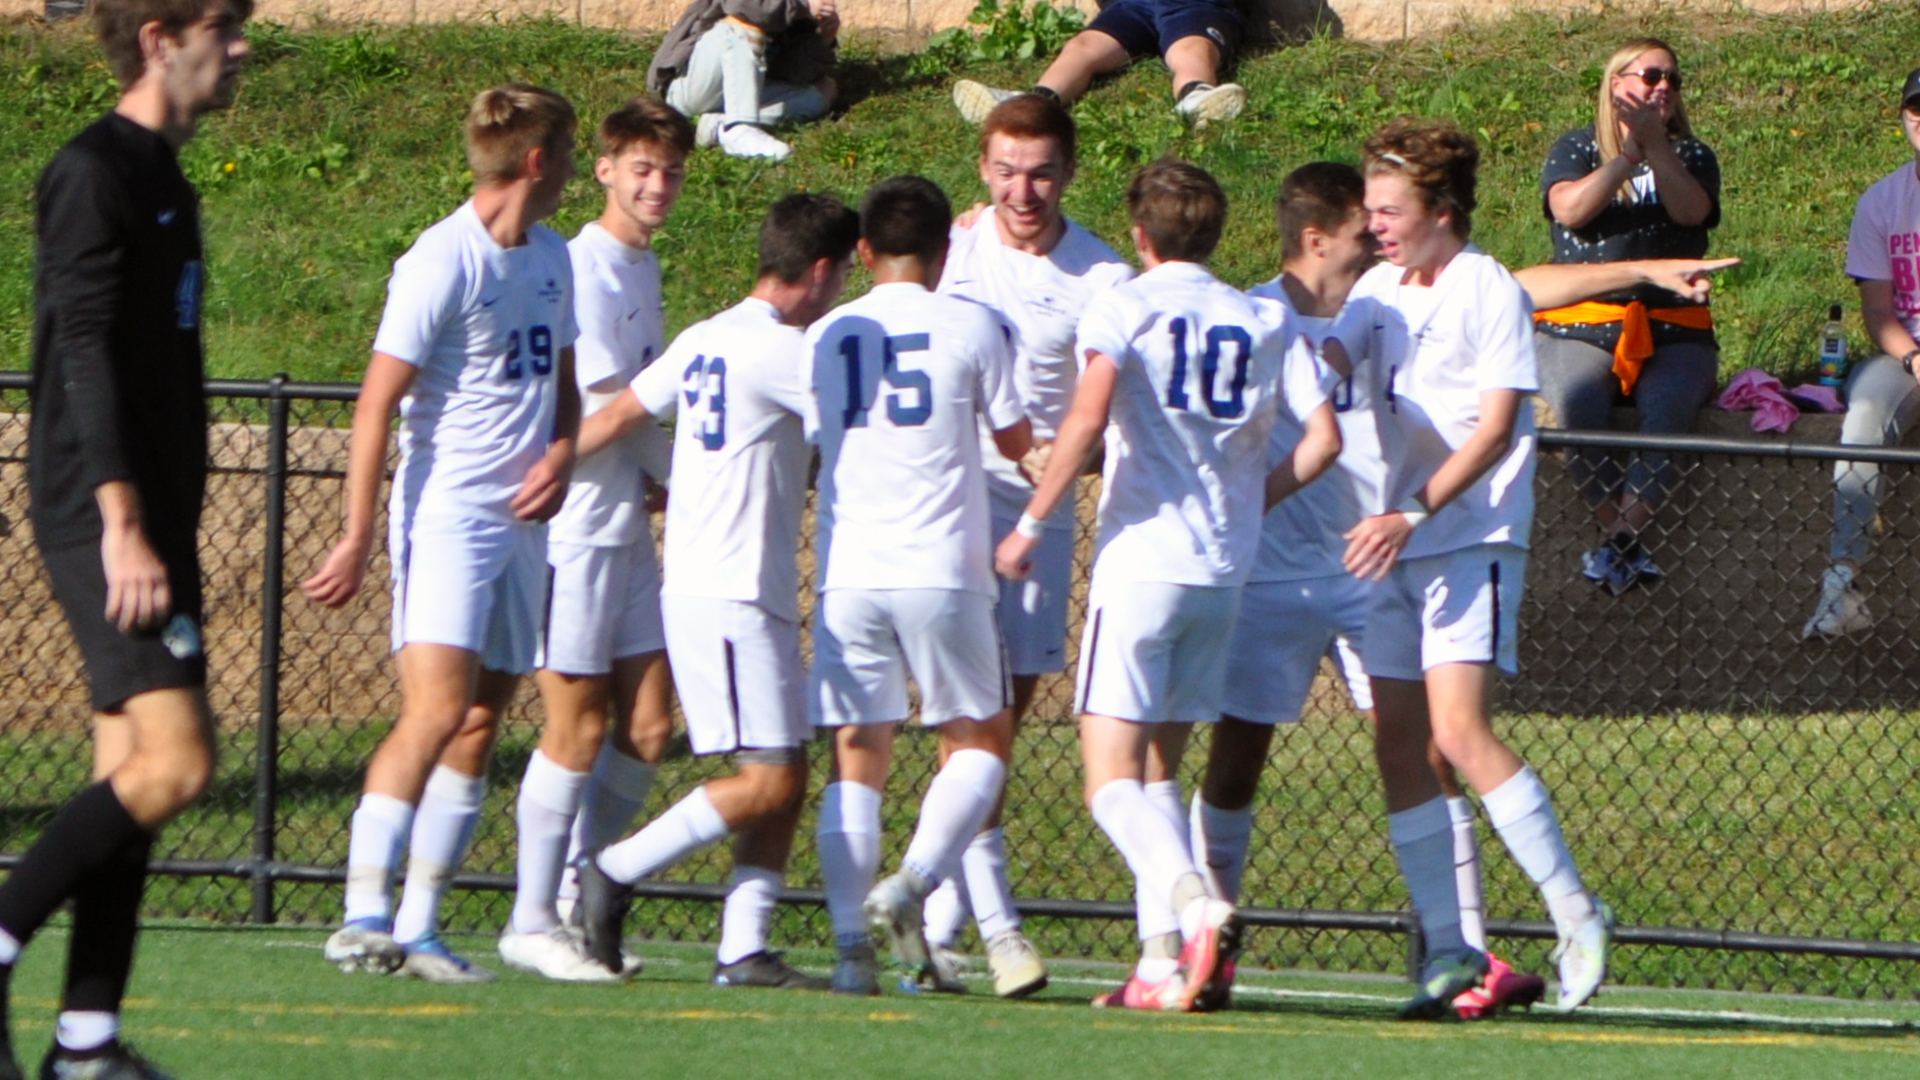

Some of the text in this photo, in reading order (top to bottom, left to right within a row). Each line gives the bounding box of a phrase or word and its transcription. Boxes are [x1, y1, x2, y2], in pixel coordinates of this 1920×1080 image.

[506, 325, 552, 379] 29
[838, 332, 932, 429] 15
[1167, 317, 1251, 419] 10
